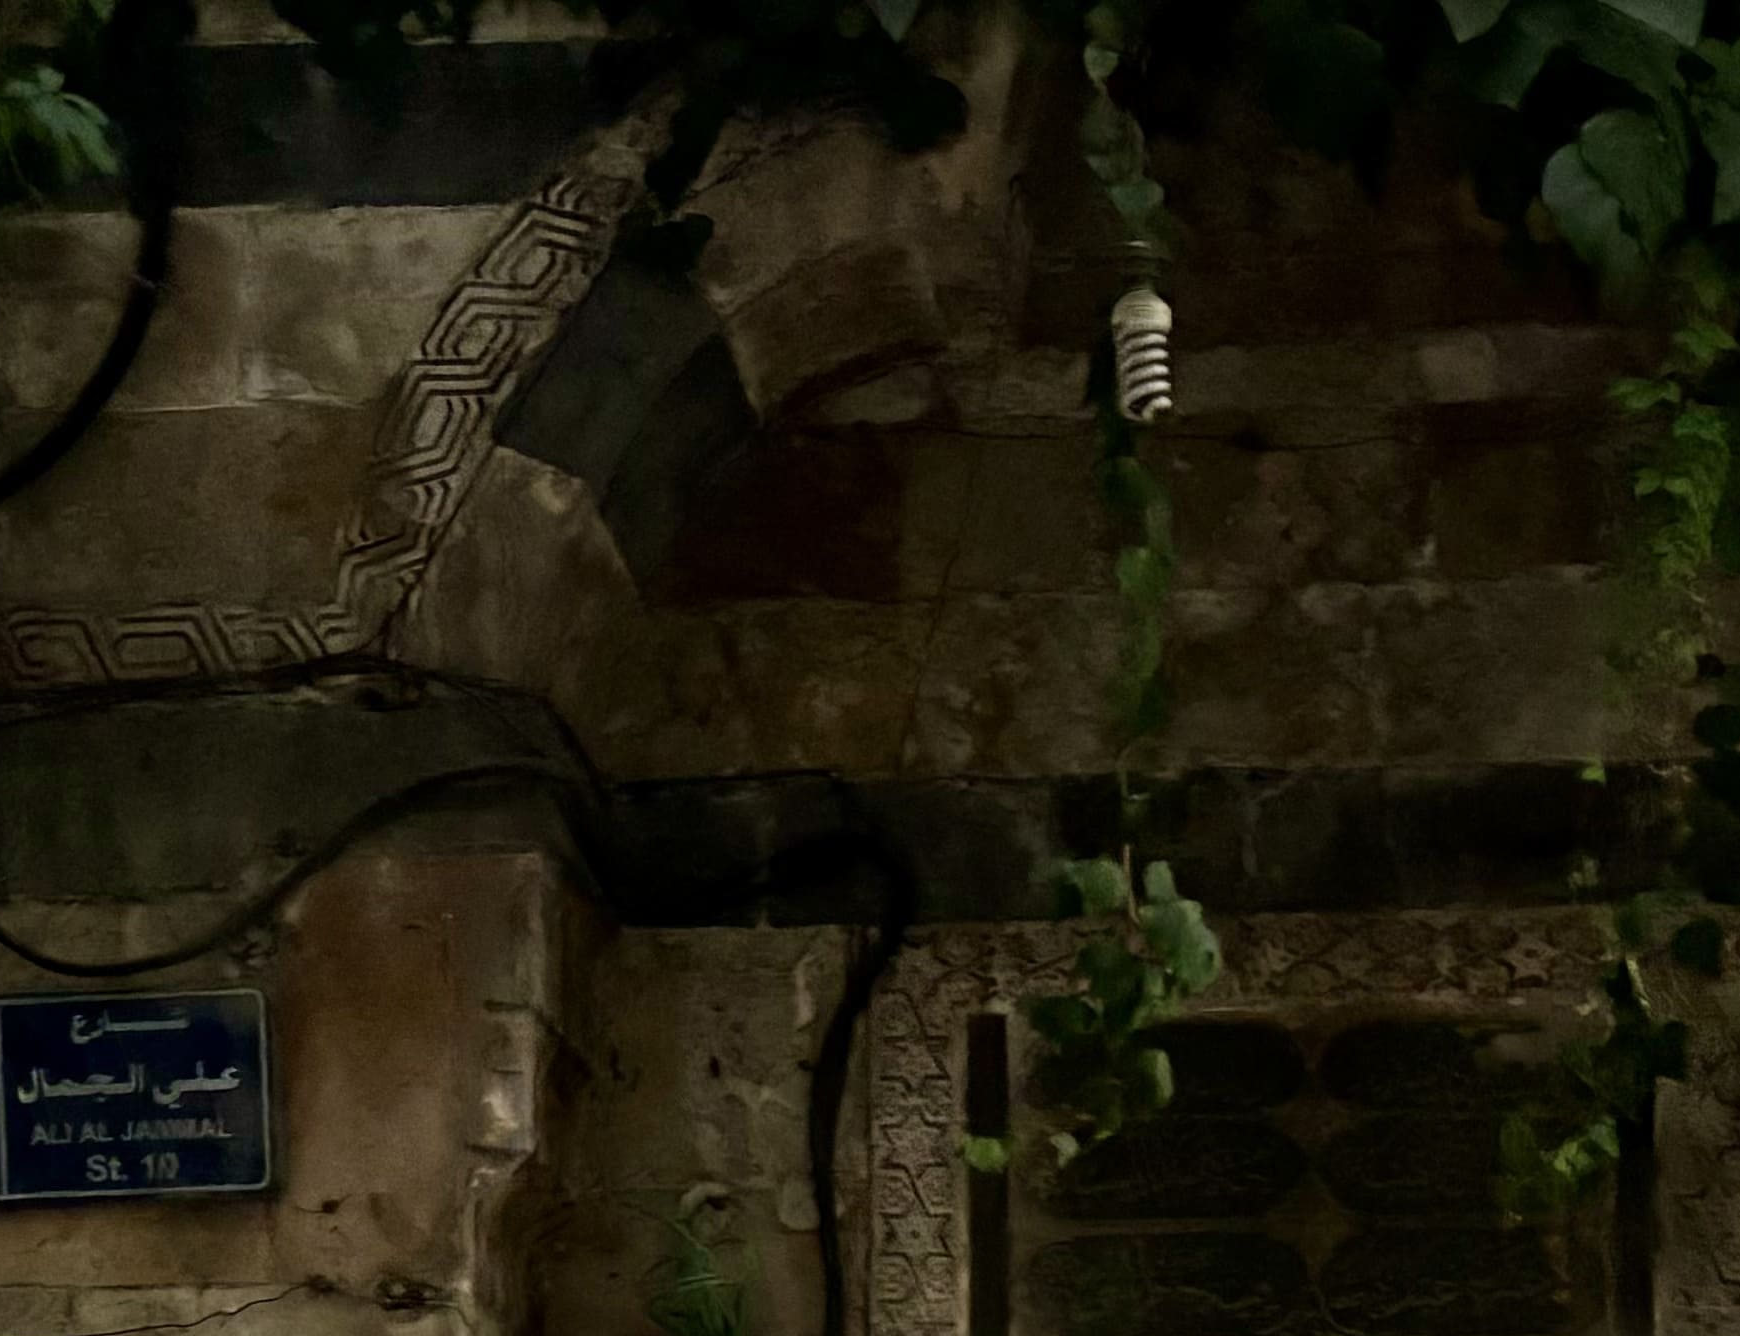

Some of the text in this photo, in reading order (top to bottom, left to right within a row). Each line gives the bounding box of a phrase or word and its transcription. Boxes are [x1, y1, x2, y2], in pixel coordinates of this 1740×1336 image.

[70, 1007, 191, 1044] شارع
[17, 1060, 242, 1109] علي الجمال
[30, 1125, 71, 1147] ALI
[79, 1122, 115, 1144] AL
[85, 1156, 129, 1183] St.
